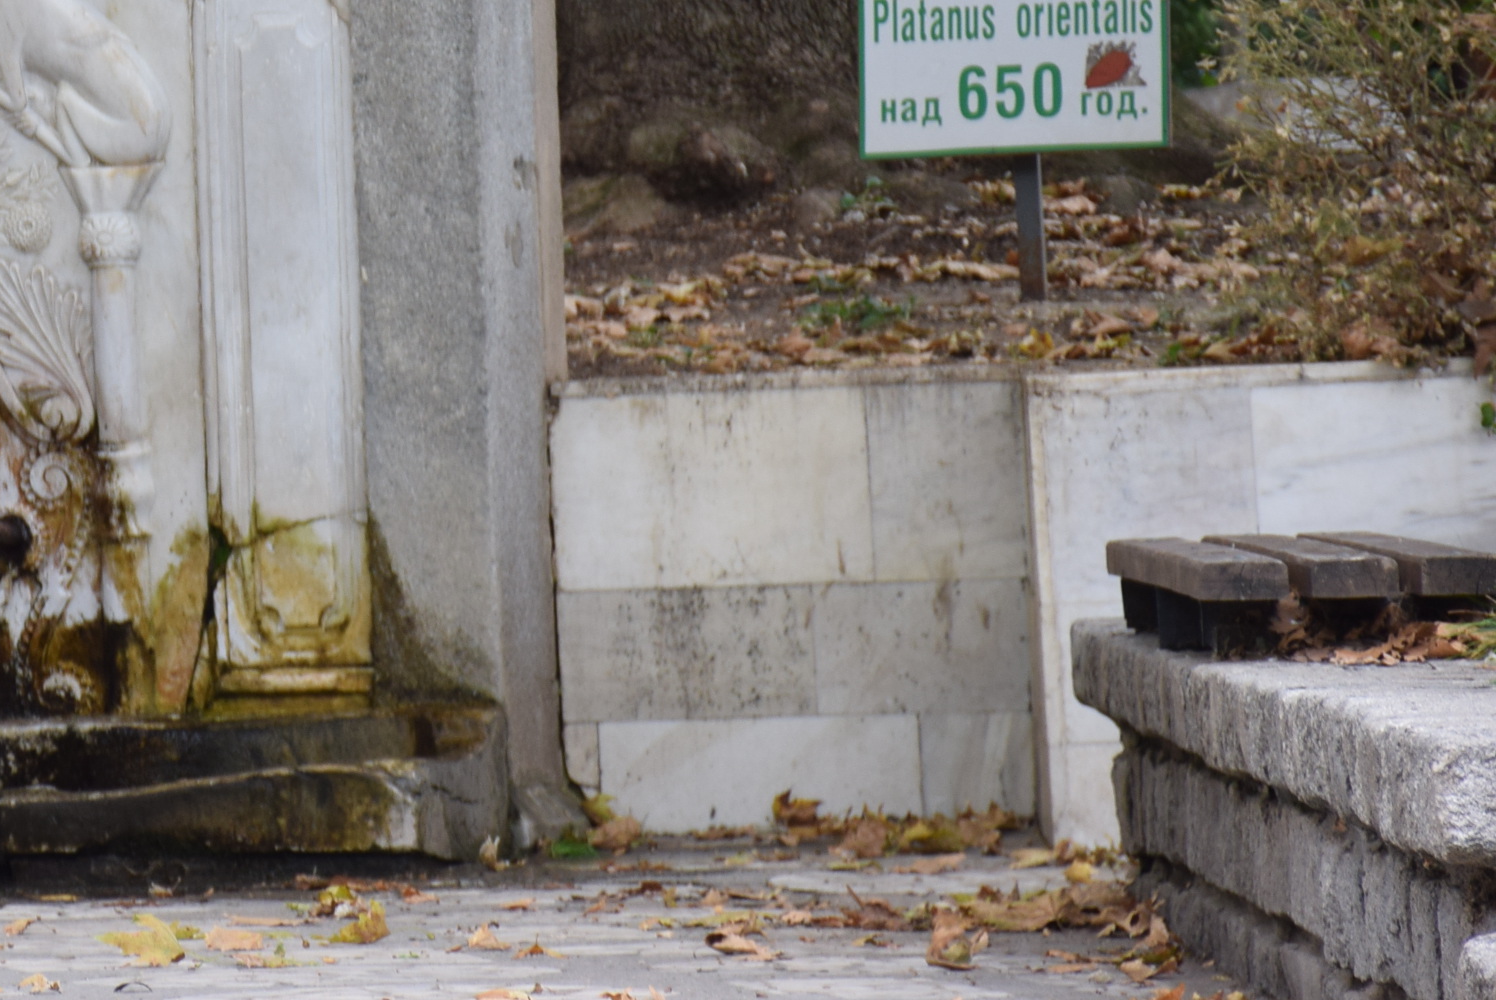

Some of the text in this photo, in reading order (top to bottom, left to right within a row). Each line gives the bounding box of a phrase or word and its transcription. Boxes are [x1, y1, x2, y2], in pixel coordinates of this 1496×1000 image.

[880, 61, 1148, 126] над 650 год.
